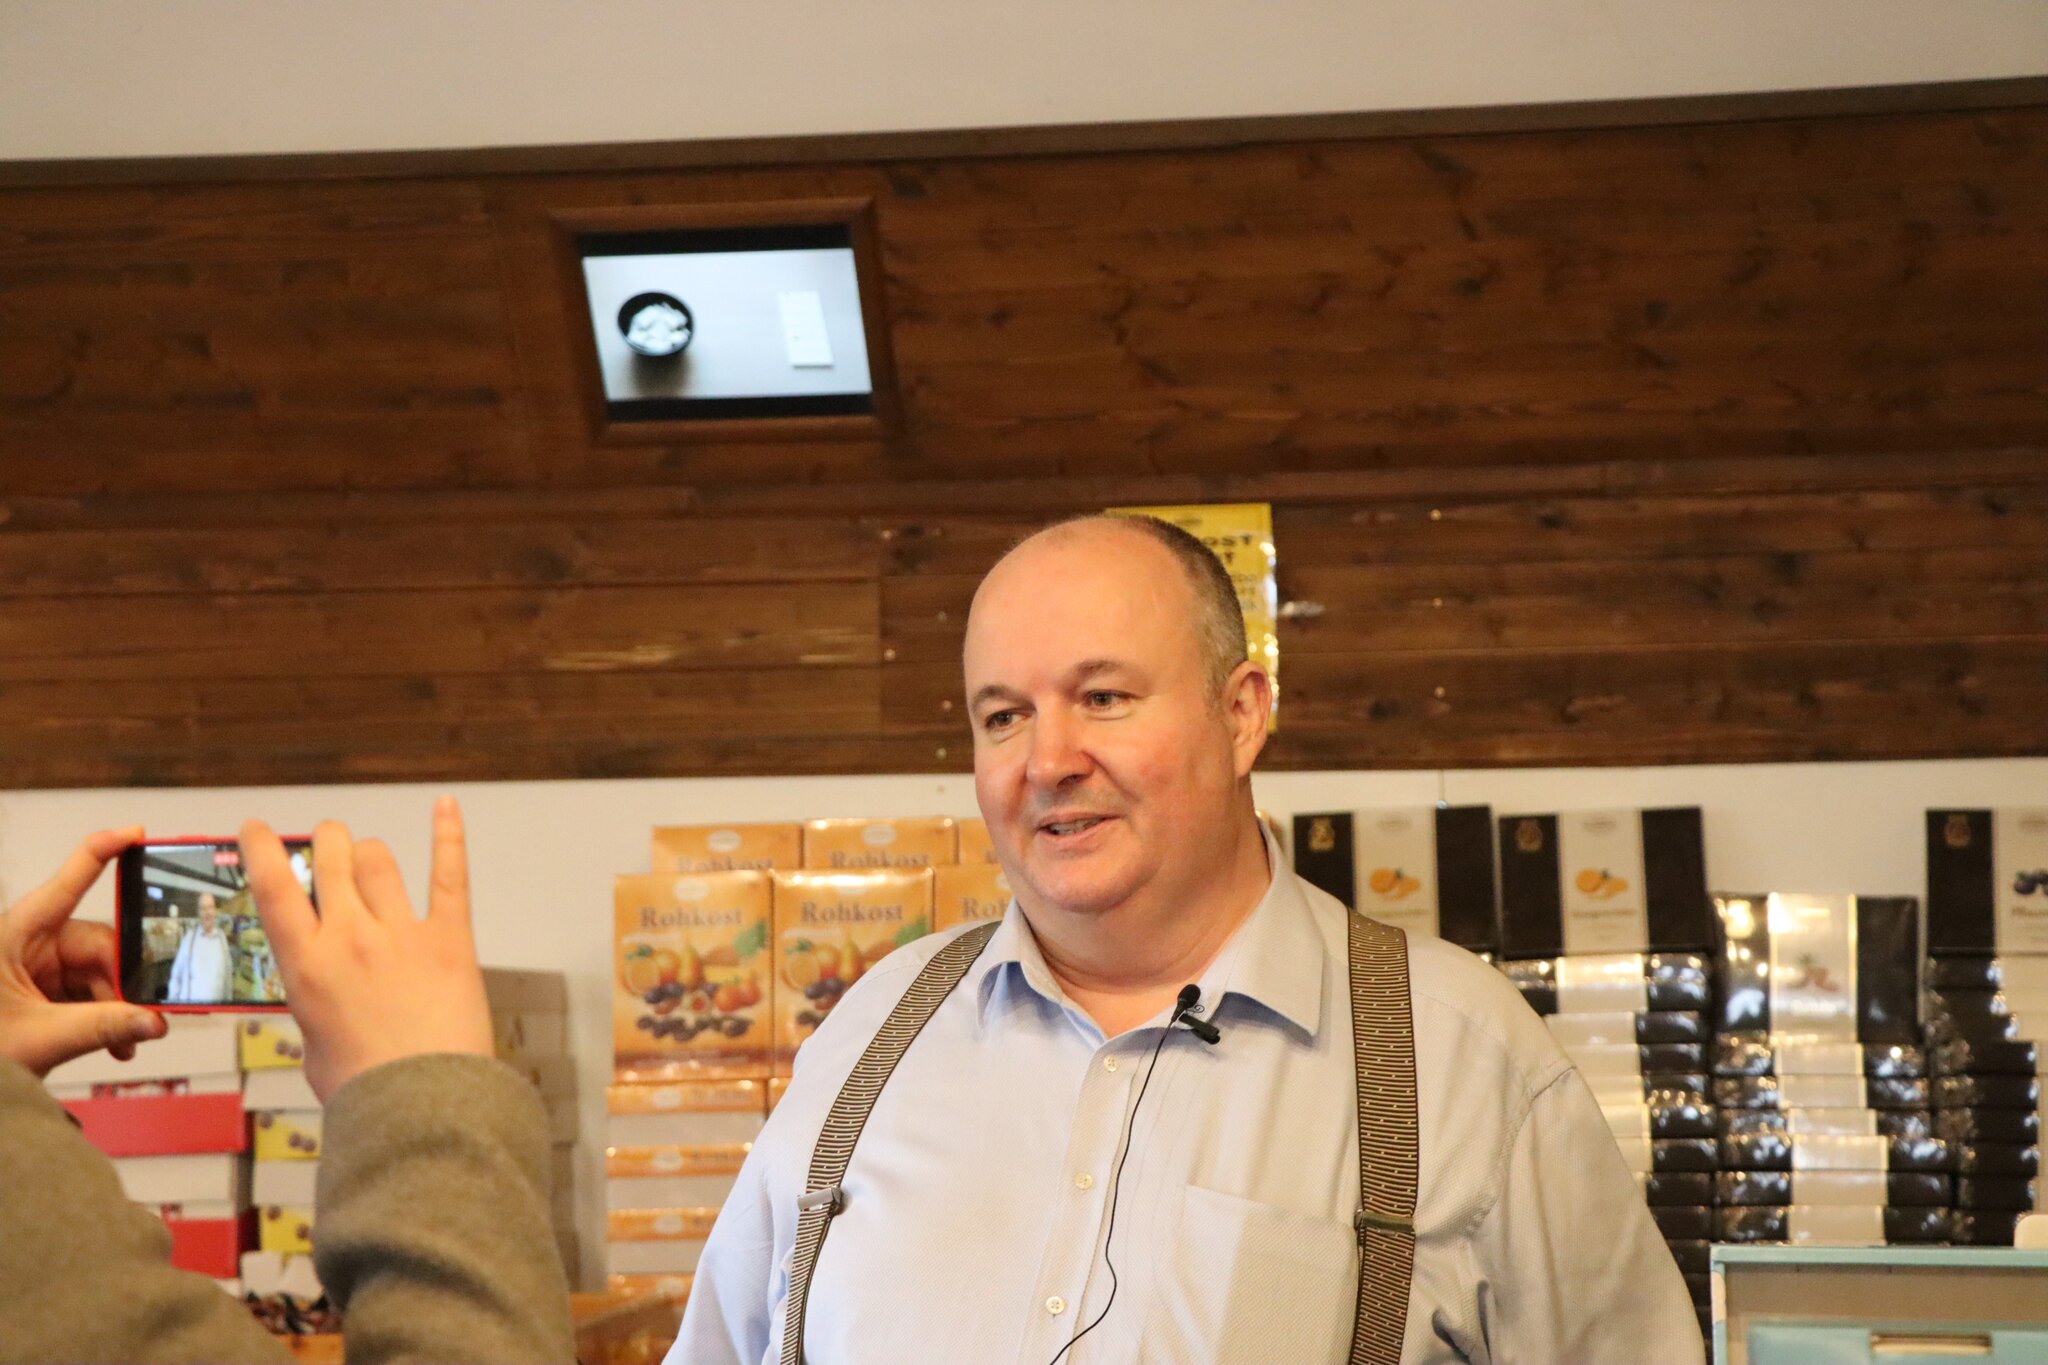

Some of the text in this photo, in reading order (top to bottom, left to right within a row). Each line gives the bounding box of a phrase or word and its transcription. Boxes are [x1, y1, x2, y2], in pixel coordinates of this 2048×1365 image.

[830, 851, 929, 867] Rohkost
[640, 907, 742, 927] Rohkost
[801, 901, 903, 921] Rohkost
